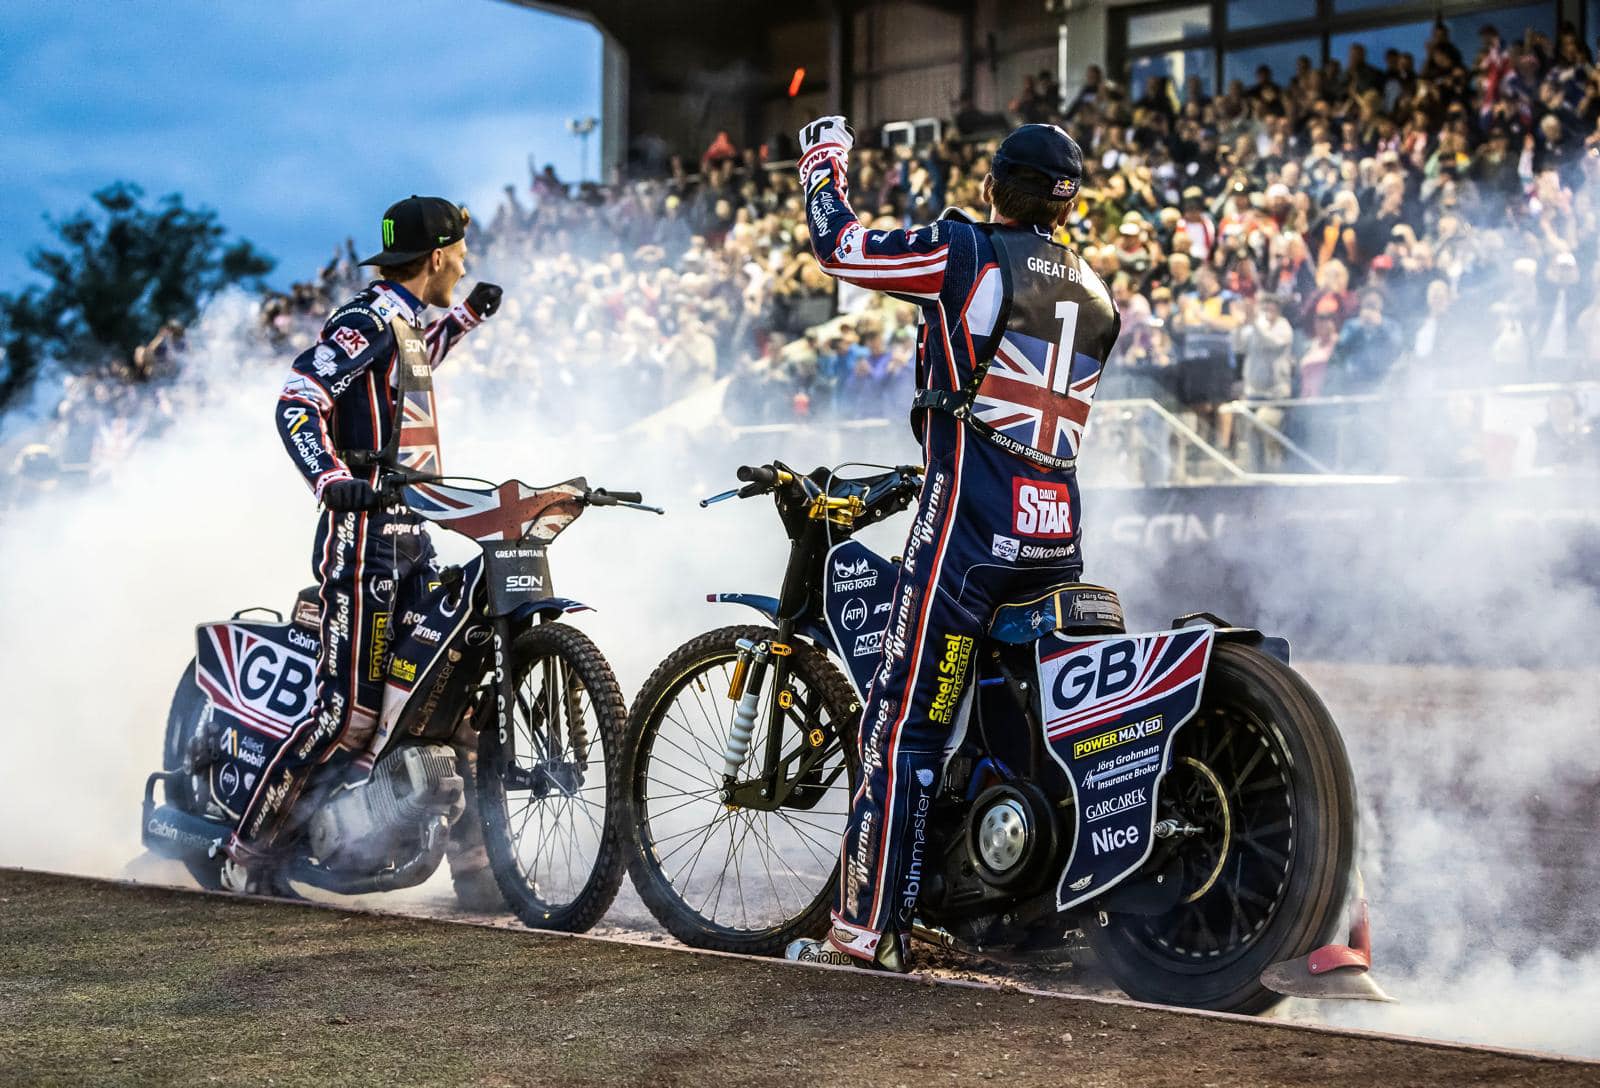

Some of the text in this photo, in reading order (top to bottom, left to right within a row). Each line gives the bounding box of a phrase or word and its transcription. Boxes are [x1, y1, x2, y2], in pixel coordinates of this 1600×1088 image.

[820, 191, 839, 214] Allied
[1027, 257, 1066, 278] GREAT
[405, 340, 428, 352] SON
[1052, 300, 1079, 395] 1
[291, 433, 323, 474] Mobility
[991, 431, 1011, 447] 2024
[1011, 441, 1025, 454] FIM
[1025, 447, 1055, 467] SPEEDWAY
[1055, 459, 1062, 467] OF
[920, 472, 945, 545] Warnes
[1017, 484, 1071, 534] STAR
[1040, 489, 1057, 500] DAILY
[345, 511, 355, 547] oger
[382, 523, 412, 535] Roger
[905, 516, 924, 575] Roger
[495, 549, 544, 558] GREAT BRITAIN
[995, 543, 1017, 554] FUCHS
[1020, 543, 1076, 559] Silkolene
[376, 580, 393, 591] ATP
[505, 575, 543, 588] SON
[336, 592, 349, 640] Roger
[845, 607, 864, 621] ATPI
[892, 585, 912, 659] Warnes
[328, 618, 340, 677] Warnes
[372, 617, 388, 678] POWER
[879, 628, 894, 688] Roger
[962, 637, 973, 656] FIX
[239, 644, 313, 718] GB
[929, 634, 962, 723] Steel Seal
[1052, 639, 1137, 710] GB
[299, 711, 332, 760] Warnes
[869, 698, 889, 768] Warnes
[1076, 718, 1161, 756] POWER MAXED
[1097, 745, 1160, 773] Jörg Grohmann
[1097, 763, 1160, 790] Insurance Broker
[1085, 787, 1147, 820] GARCAREK
[856, 810, 872, 886] Warnes
[1091, 825, 1139, 856] Nice
